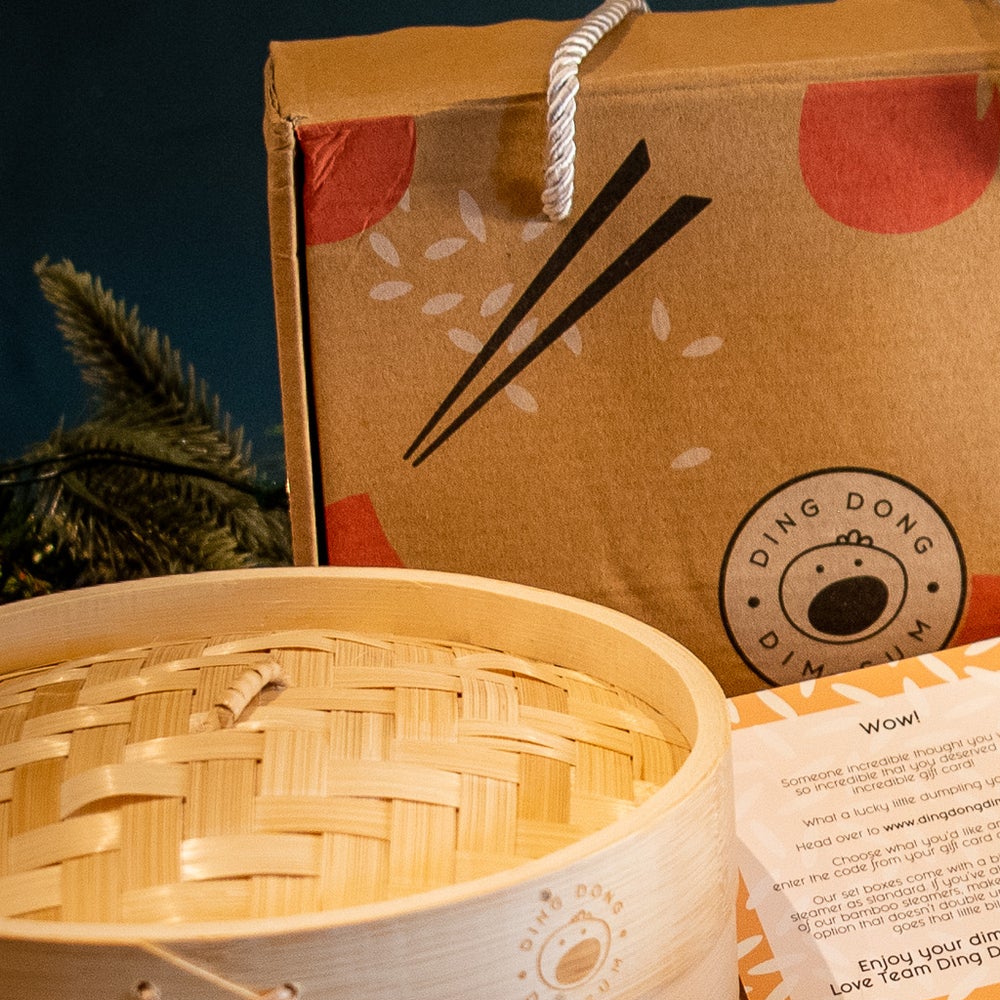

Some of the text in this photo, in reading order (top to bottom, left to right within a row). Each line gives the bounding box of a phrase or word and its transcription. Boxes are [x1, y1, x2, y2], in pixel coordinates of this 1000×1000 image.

[750, 492, 933, 568] DING DONG
[759, 619, 931, 678] DIM UM
[859, 710, 920, 734] Wow!
[781, 767, 844, 788] Someone
[847, 753, 910, 773] incredible
[914, 739, 963, 759] thought
[967, 734, 993, 747] you
[795, 786, 811, 796] so
[815, 770, 877, 791] incredible
[882, 764, 906, 777] that
[910, 758, 936, 771] you
[939, 744, 997, 763] deserved
[851, 772, 915, 794] incredible
[919, 768, 938, 781] gift
[802, 813, 837, 828] What
[841, 811, 850, 819] a
[853, 803, 889, 816] lucky
[893, 796, 916, 808] little
[919, 779, 982, 801] dumpling
[773, 877, 805, 891] enter
[809, 872, 830, 884] the
[834, 862, 868, 877] code
[870, 855, 902, 872] from
[904, 847, 935, 863] your
[939, 841, 959, 855] gift
[962, 833, 993, 847] card
[795, 837, 832, 852] Head
[835, 830, 863, 843] over
[867, 826, 880, 836] to
[832, 848, 882, 866] Choose
[885, 840, 918, 854] what
[962, 824, 983, 835] like
[812, 892, 838, 905] Our
[841, 887, 859, 899] set
[863, 877, 903, 894] boxes
[906, 868, 943, 883] come
[948, 861, 974, 873] with
[976, 858, 986, 867] a
[519, 883, 623, 952] DING DONG
[790, 903, 842, 922] steamer
[846, 898, 863, 909] as
[798, 919, 811, 933] of
[814, 916, 837, 928] our
[840, 902, 899, 922] bamboo
[813, 924, 856, 940] option
[859, 916, 885, 929] that
[888, 904, 936, 922] doesn't
[939, 892, 985, 910] double
[893, 918, 925, 935] goes
[929, 911, 954, 924] that
[957, 906, 981, 918] little
[985, 900, 1000, 911] bit
[830, 976, 874, 996] Love
[878, 963, 932, 984] Team
[936, 951, 983, 972] Ding
[858, 952, 913, 973] Enjoy
[918, 940, 962, 960] your
